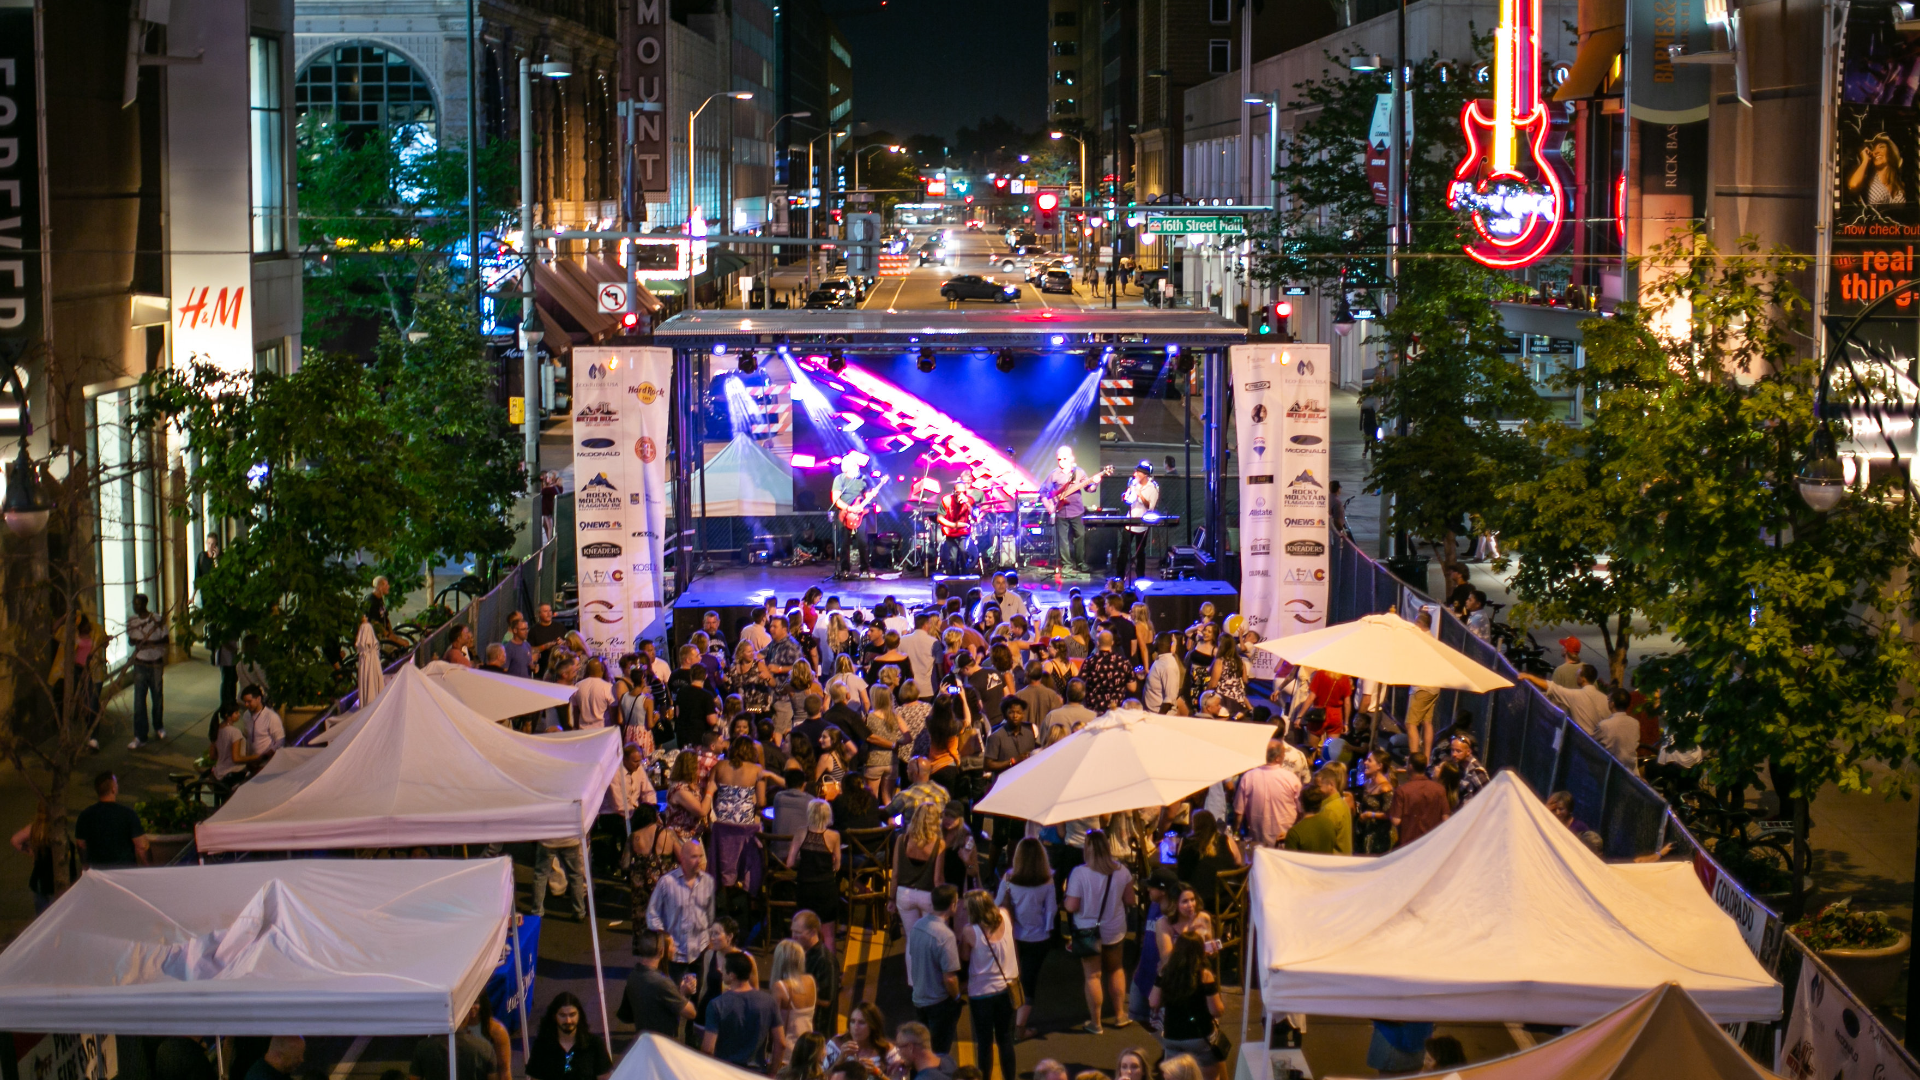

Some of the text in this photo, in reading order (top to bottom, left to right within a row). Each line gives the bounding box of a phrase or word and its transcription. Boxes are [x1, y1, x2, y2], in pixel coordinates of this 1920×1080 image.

[1665, 154, 1678, 187] RICK
[1162, 220, 1241, 231] 16th Street Mall
[1869, 223, 1901, 235] check
[1862, 245, 1914, 271] real
[178, 286, 245, 330] H&M
[579, 521, 611, 531] 9NEWS
[1284, 517, 1315, 527] 9NEWS
[583, 547, 620, 555] KNEADERS
[1287, 545, 1323, 553] KNEADERS
[1714, 878, 1755, 933] COLORADO
